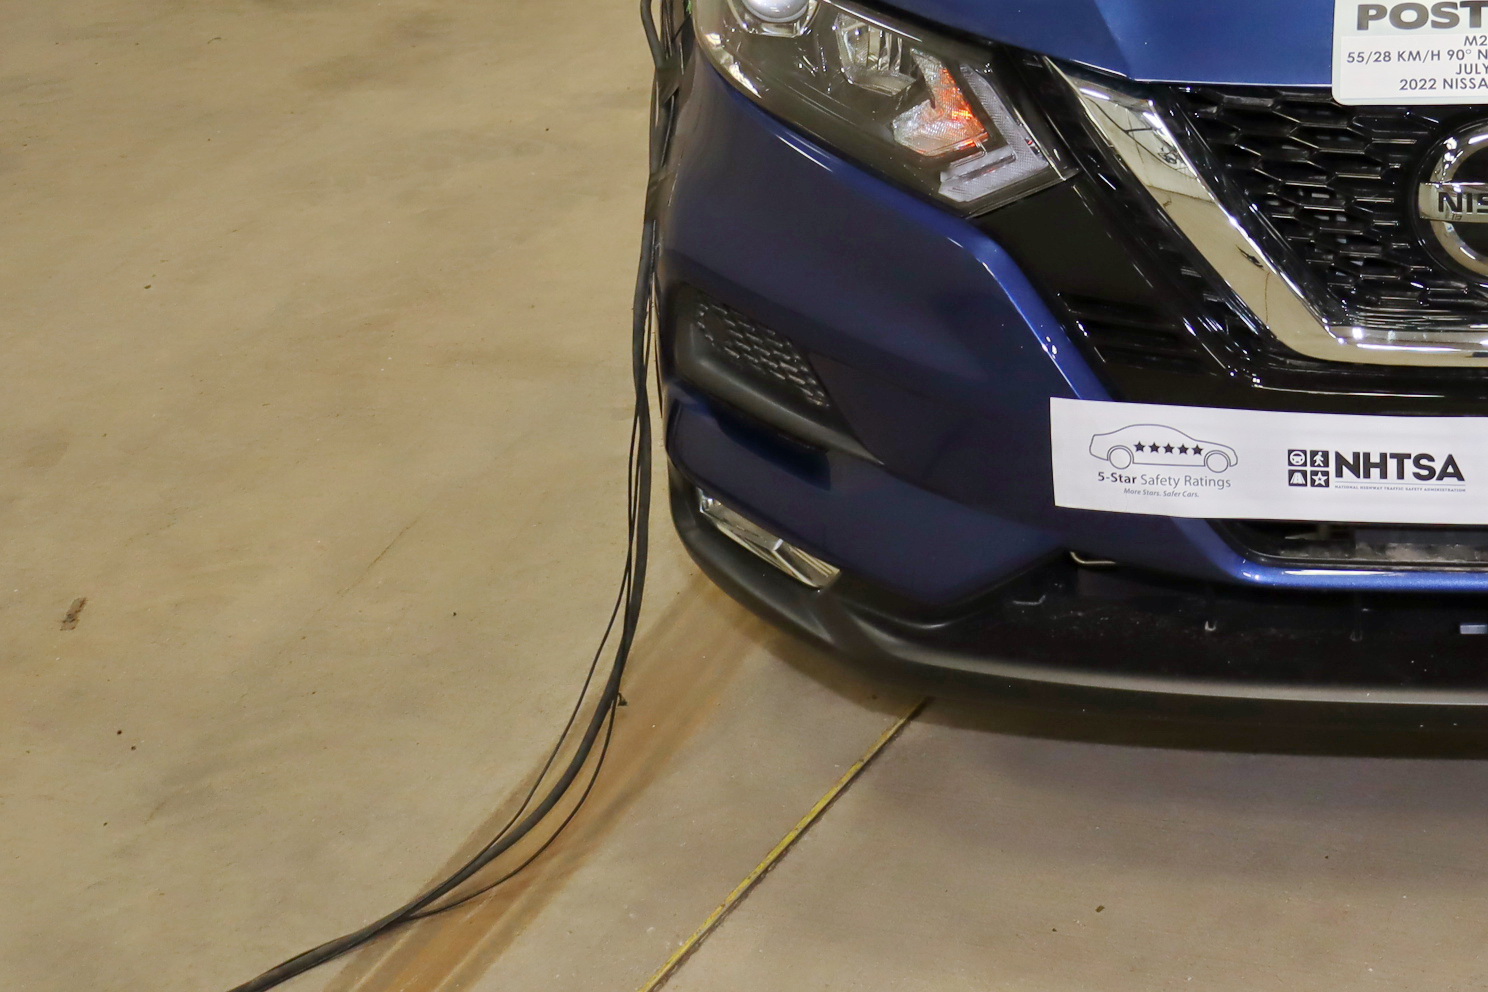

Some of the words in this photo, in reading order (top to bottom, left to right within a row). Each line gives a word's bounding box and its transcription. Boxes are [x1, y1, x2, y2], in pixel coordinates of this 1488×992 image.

[1347, 51, 1391, 64] 55/28
[1398, 50, 1440, 63] KM/H
[1447, 50, 1471, 60] 90°
[1400, 78, 1436, 90] 2022
[1335, 451, 1465, 481] NHTSA
[1098, 472, 1136, 483] 5-Star
[1141, 475, 1179, 488] Safety
[1185, 476, 1230, 489] Ratings
[1123, 487, 1142, 495] More
[1142, 489, 1162, 497] Stars.
[1182, 490, 1200, 498] Cars.
